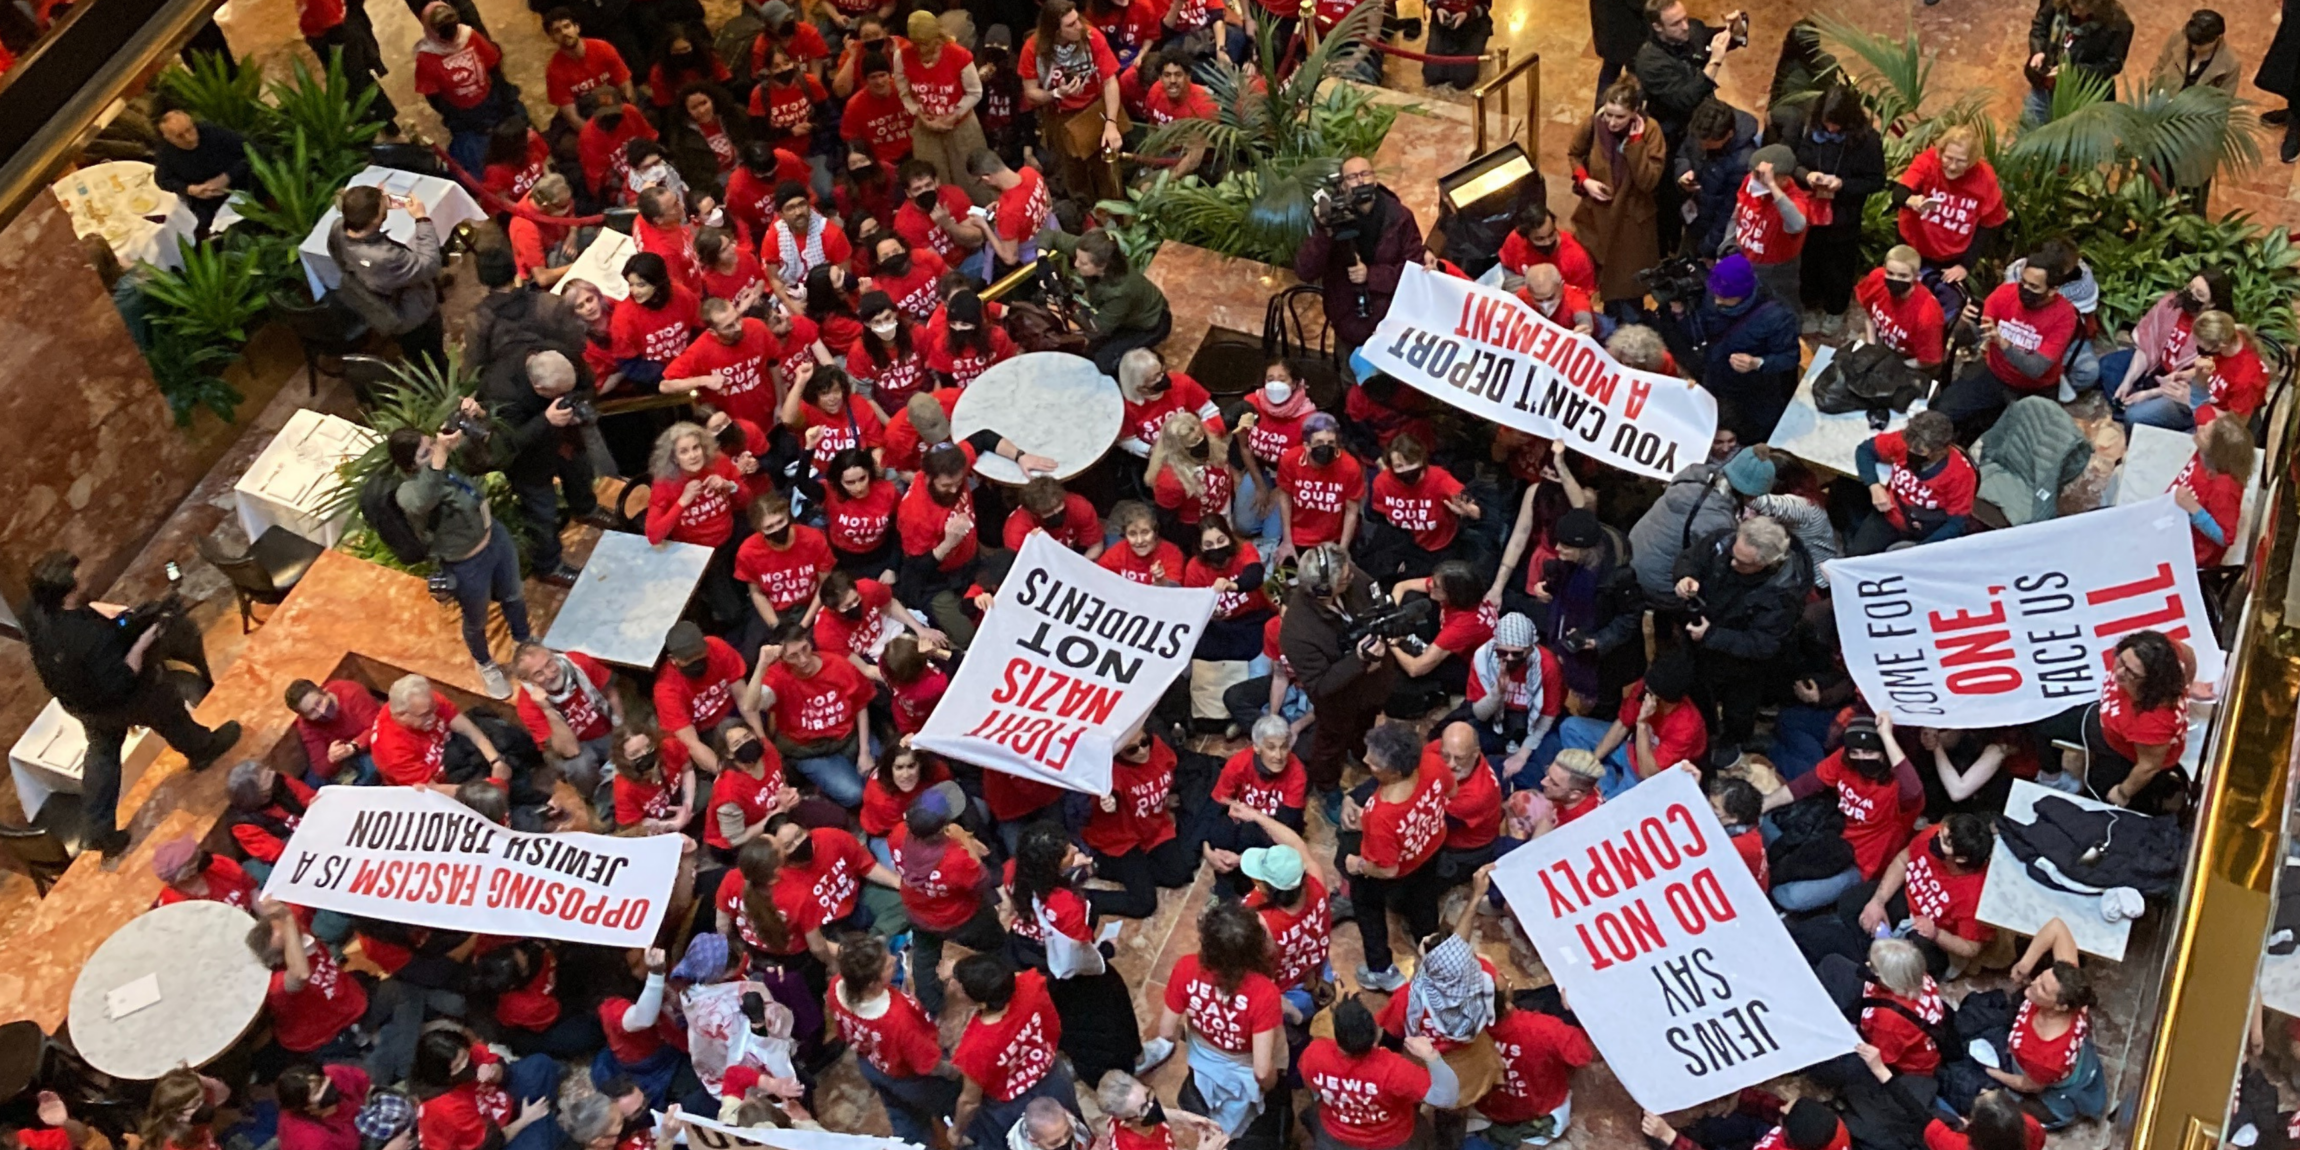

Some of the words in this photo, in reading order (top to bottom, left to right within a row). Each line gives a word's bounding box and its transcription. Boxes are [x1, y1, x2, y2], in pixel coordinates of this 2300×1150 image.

[771, 98, 808, 117] STOP
[939, 83, 955, 95] IN
[1153, 109, 1174, 123] NOT
[1960, 198, 1979, 210] IN
[897, 288, 922, 309] NOT
[925, 276, 937, 292] IN
[908, 290, 936, 313] OUR
[646, 322, 684, 344] STOP
[1454, 292, 1621, 406] MOVEMENT
[1893, 325, 1909, 341] IN
[747, 356, 761, 367] IN
[1388, 327, 1516, 403] DEPORT
[1514, 364, 1608, 444] CAN'T
[1623, 379, 1653, 421] A
[821, 438, 857, 451] OUR
[823, 427, 840, 438] OT
[1251, 426, 1289, 444] STOP
[1610, 423, 1678, 474] YOU
[814, 449, 837, 462] NA
[1295, 480, 1325, 491] NOT
[1328, 482, 1344, 492] IN
[1299, 489, 1338, 504] OUR
[1385, 495, 1417, 507] NOT
[1419, 499, 1433, 509] IN
[838, 513, 869, 528] NOT
[1391, 509, 1429, 522] OUR
[761, 568, 793, 584] NOT
[799, 564, 815, 578] IN
[771, 577, 810, 592] OUR
[2013, 571, 2075, 616] US
[866, 606, 878, 622] IN
[1016, 567, 1191, 659] STUDENTS
[1857, 573, 1918, 639] FOR
[854, 622, 880, 653] OUR
[1016, 621, 1144, 684] NOT
[1928, 585, 2024, 695] ONE,
[2028, 624, 2098, 699] FACE
[991, 657, 1123, 725] NAZIS
[963, 709, 1088, 772] FIGHT
[1131, 781, 1155, 797] NOT
[1159, 770, 1171, 787] IN
[1396, 779, 1443, 834] JEWS
[346, 810, 498, 855] TRADITION
[290, 851, 318, 884] A
[316, 854, 350, 890] IS
[503, 835, 630, 887] JEWISH
[813, 875, 828, 897] OT
[831, 857, 847, 876] IN
[1537, 803, 1708, 919] COMPLY
[1917, 855, 1950, 904] STOP
[349, 859, 482, 906] FASCISM
[487, 867, 651, 931] OPPOSING
[818, 873, 849, 908] OUR
[821, 878, 856, 925] NAME
[1663, 867, 1738, 936] DO
[1907, 861, 1943, 918] ARMING
[1278, 898, 1327, 946] JEWS
[1285, 916, 1324, 956] SAY
[1574, 898, 1668, 971] NOT
[1650, 947, 1733, 1017] SAY
[1190, 995, 1238, 1022] SAY
[997, 1011, 1042, 1066] JEWS
[1665, 999, 1781, 1077] JEWS
[1313, 1072, 1379, 1096] JEWS
